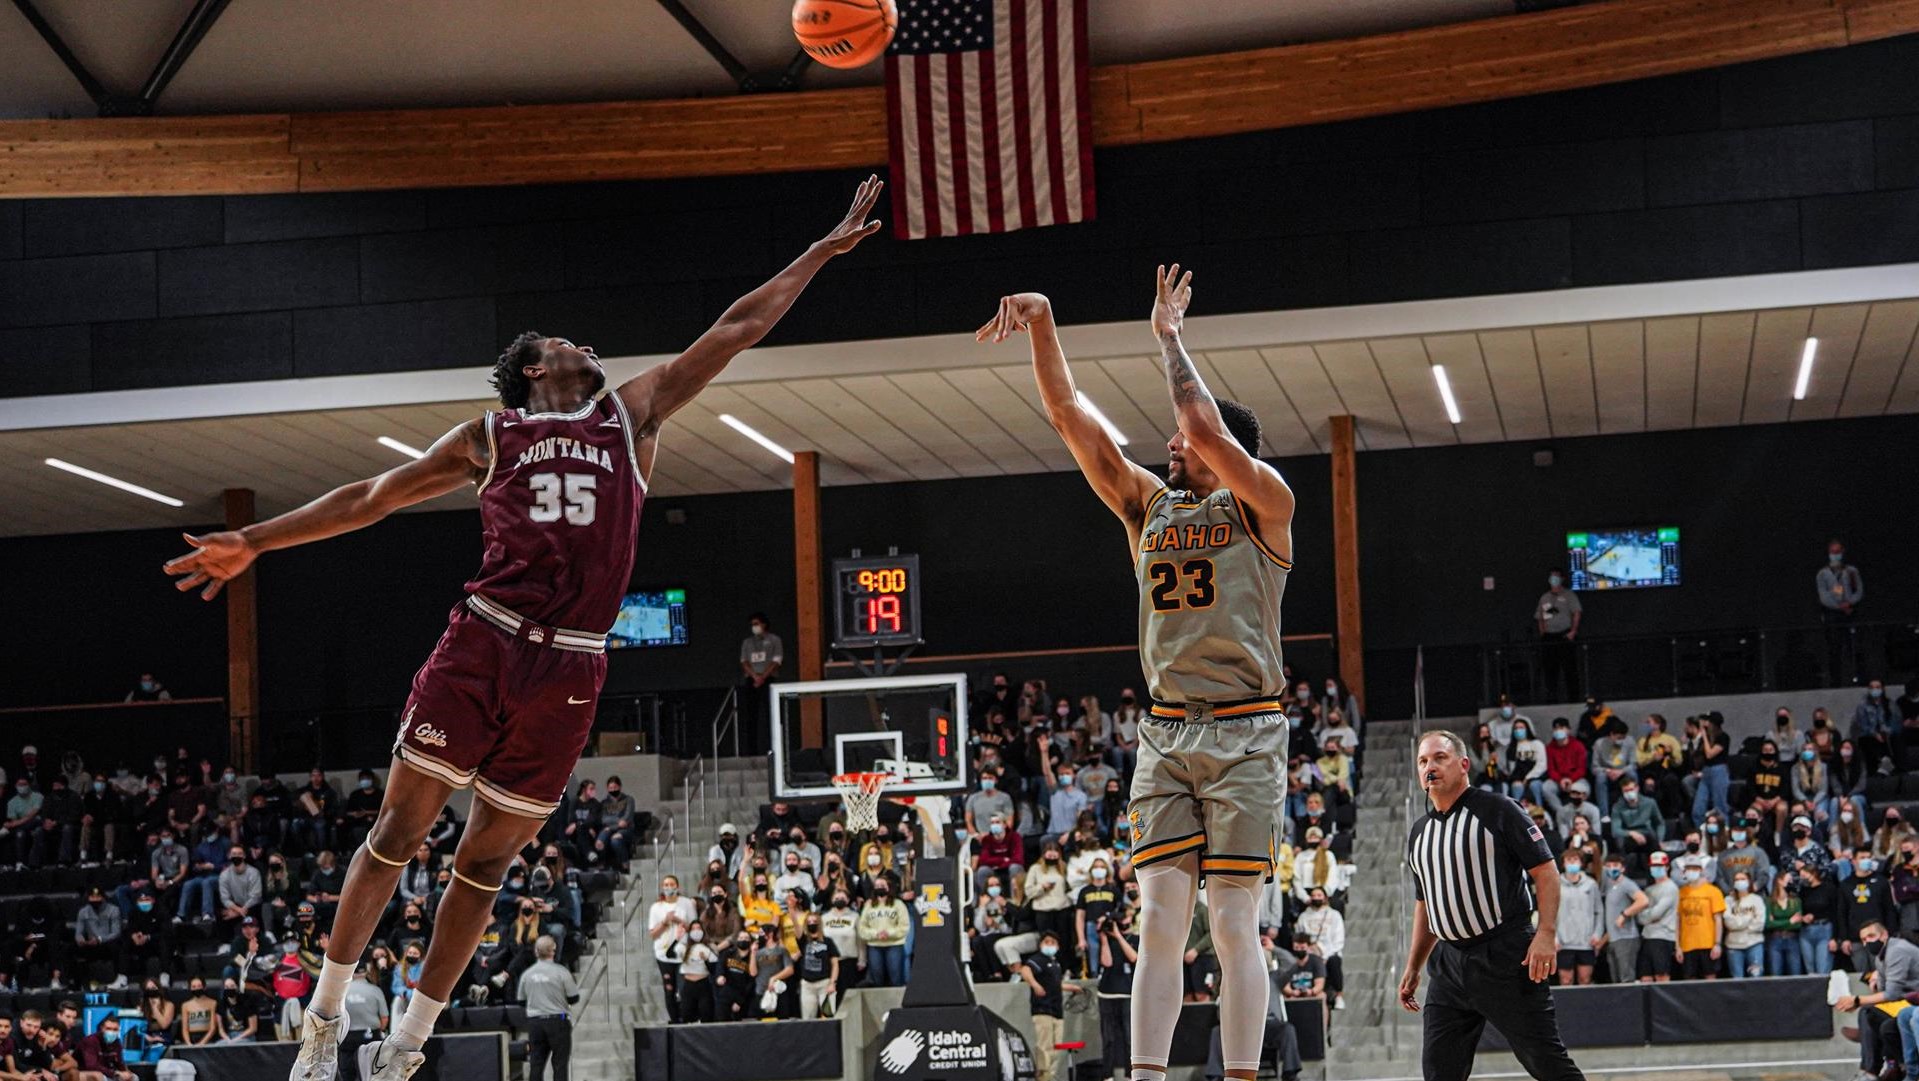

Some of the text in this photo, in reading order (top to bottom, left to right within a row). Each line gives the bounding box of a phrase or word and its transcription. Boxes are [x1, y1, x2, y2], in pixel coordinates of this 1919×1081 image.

[513, 436, 614, 474] MONTANA
[528, 471, 597, 527] 35
[1142, 521, 1232, 553] DAHO
[858, 568, 906, 593] 9:00
[1148, 556, 1217, 613] 23
[869, 595, 901, 633] 19
[928, 1029, 972, 1046] Idaho
[928, 1043, 987, 1061] Central
[928, 1058, 988, 1070] CREDIT UNION
